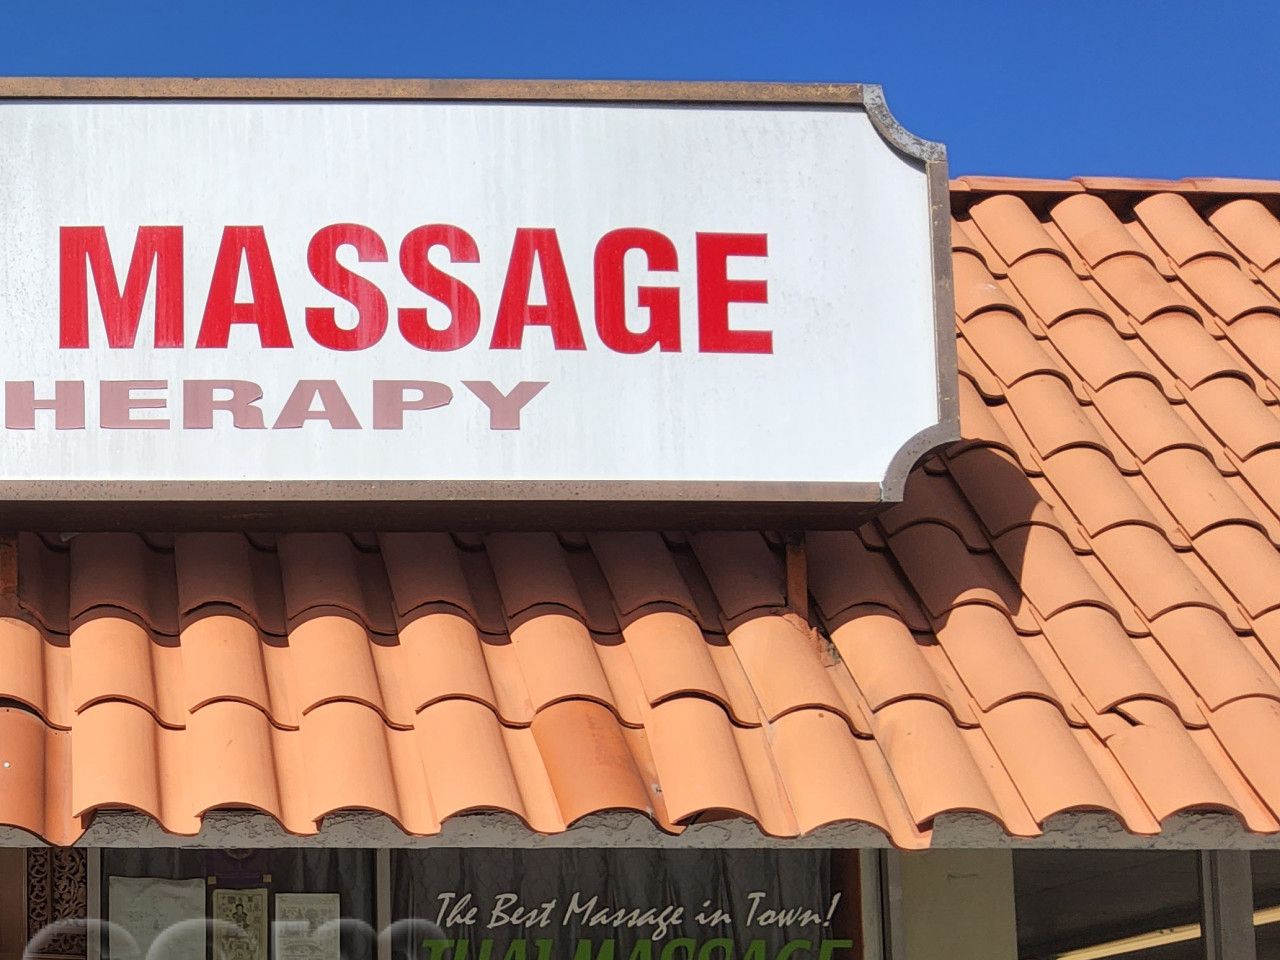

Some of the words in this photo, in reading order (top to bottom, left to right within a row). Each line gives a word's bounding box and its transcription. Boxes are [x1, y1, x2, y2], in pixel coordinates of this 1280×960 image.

[59, 222, 773, 354] MASSAGE
[434, 892, 477, 929] The
[486, 894, 557, 930] Best
[563, 892, 683, 940] Massage
[694, 899, 732, 929] in
[745, 891, 841, 929] Town!
